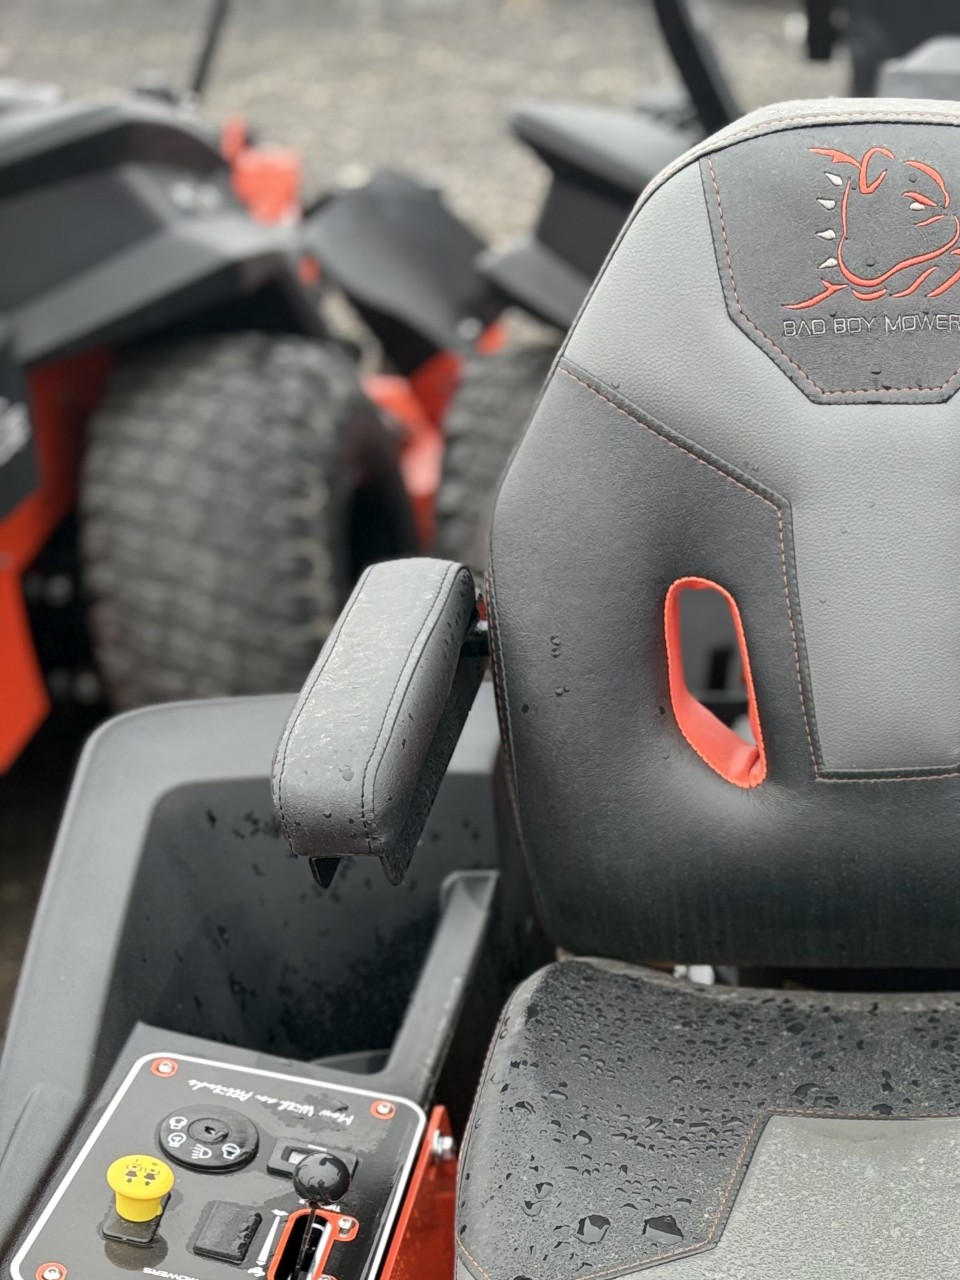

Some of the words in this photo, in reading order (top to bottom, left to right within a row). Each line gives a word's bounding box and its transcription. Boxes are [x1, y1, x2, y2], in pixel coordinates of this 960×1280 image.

[783, 319, 826, 337] BAD
[833, 317, 875, 334] BOY
[318, 1109, 355, 1126] Mow
